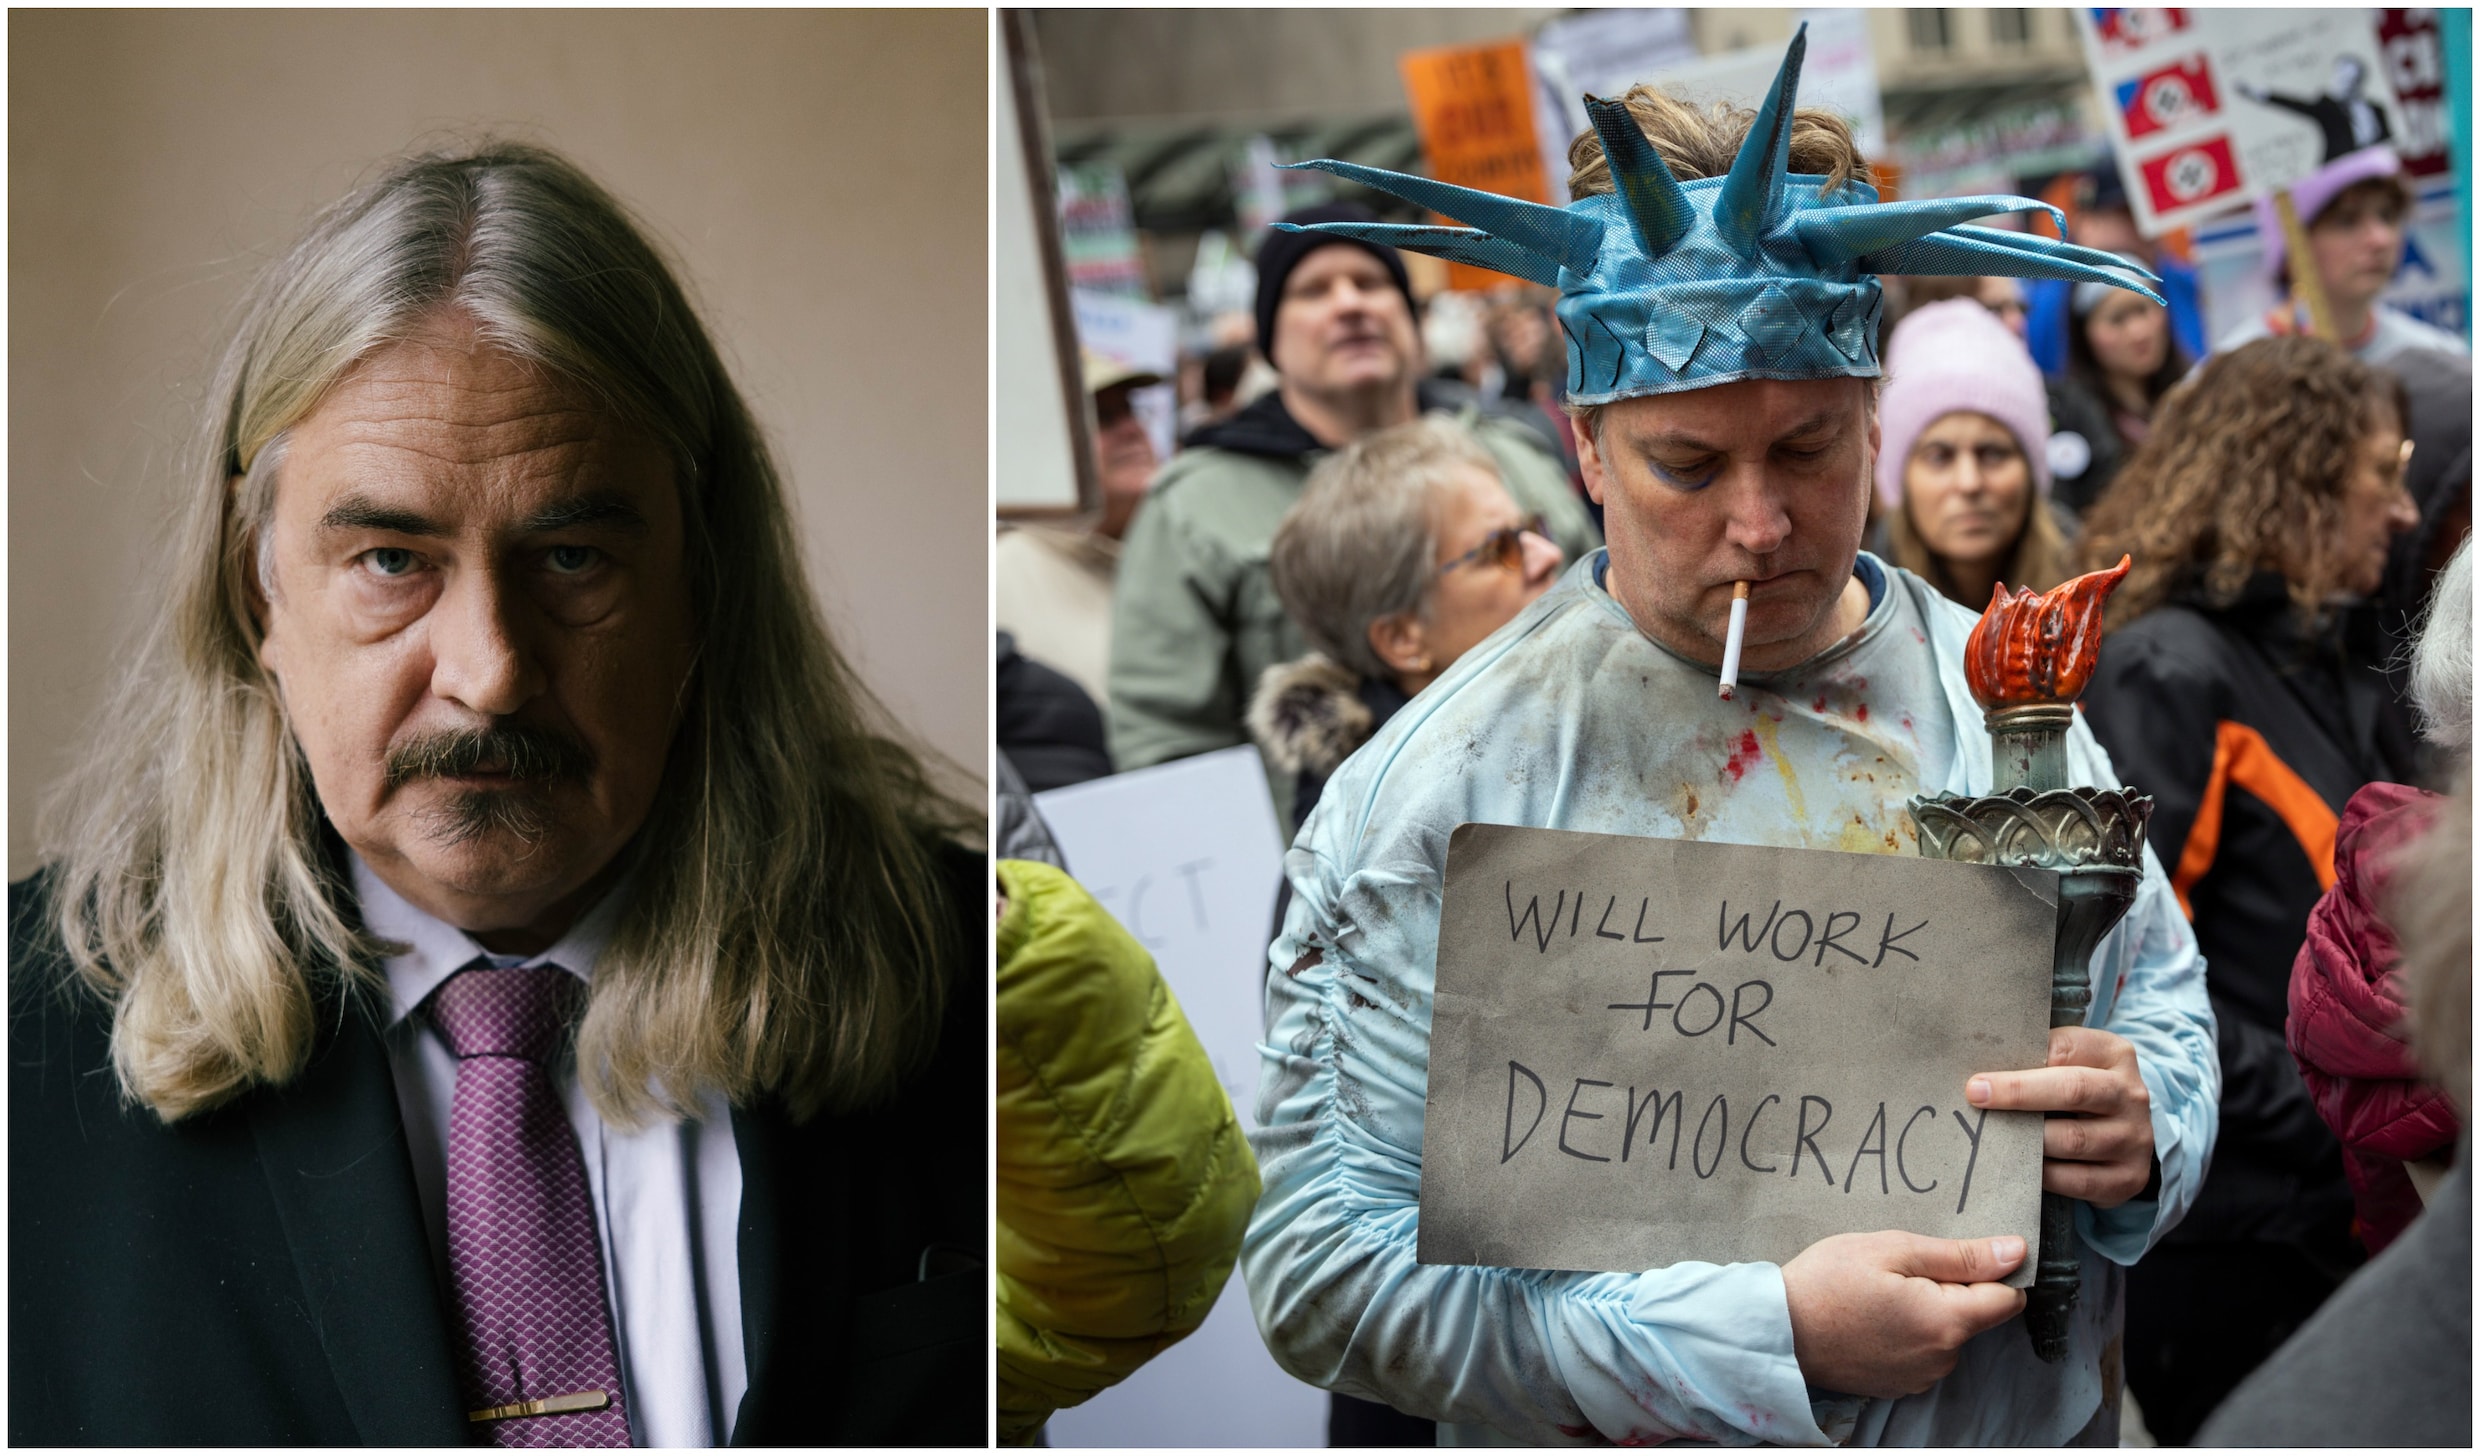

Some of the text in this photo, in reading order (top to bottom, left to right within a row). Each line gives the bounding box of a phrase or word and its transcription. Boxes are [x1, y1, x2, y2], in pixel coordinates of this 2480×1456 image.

[1092, 854, 1218, 950] CT
[1504, 879, 1930, 970] WILL WORK
[1606, 968, 1778, 1048] FOR
[1499, 1059, 1988, 1216] DEMOCRACY
